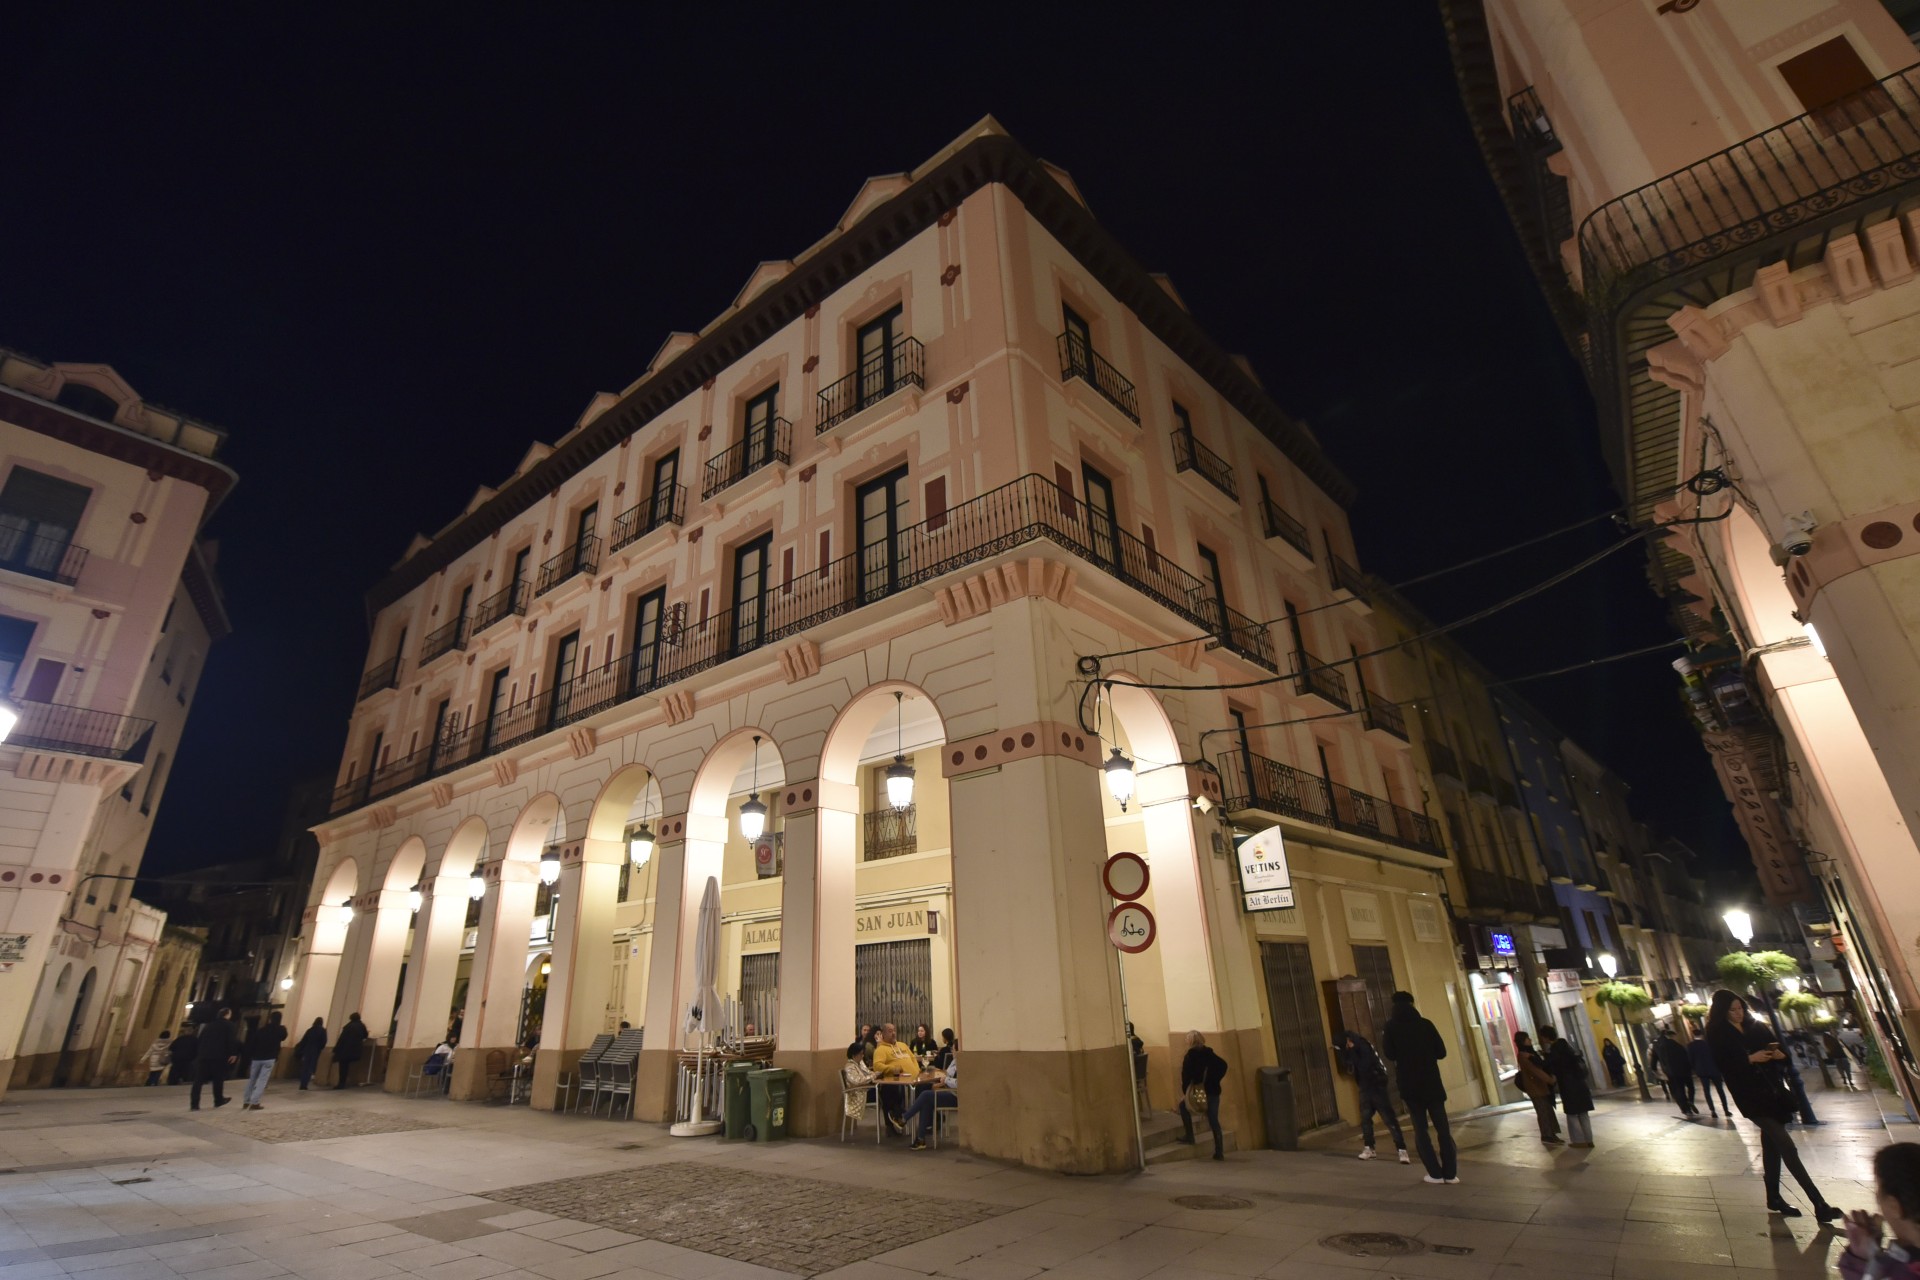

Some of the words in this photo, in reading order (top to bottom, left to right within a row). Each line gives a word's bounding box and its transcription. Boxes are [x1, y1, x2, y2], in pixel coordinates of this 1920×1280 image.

[1249, 896, 1261, 906] Alt
[1262, 893, 1289, 905] Berlin
[856, 914, 881, 932] SAN
[887, 909, 923, 929] JUAN
